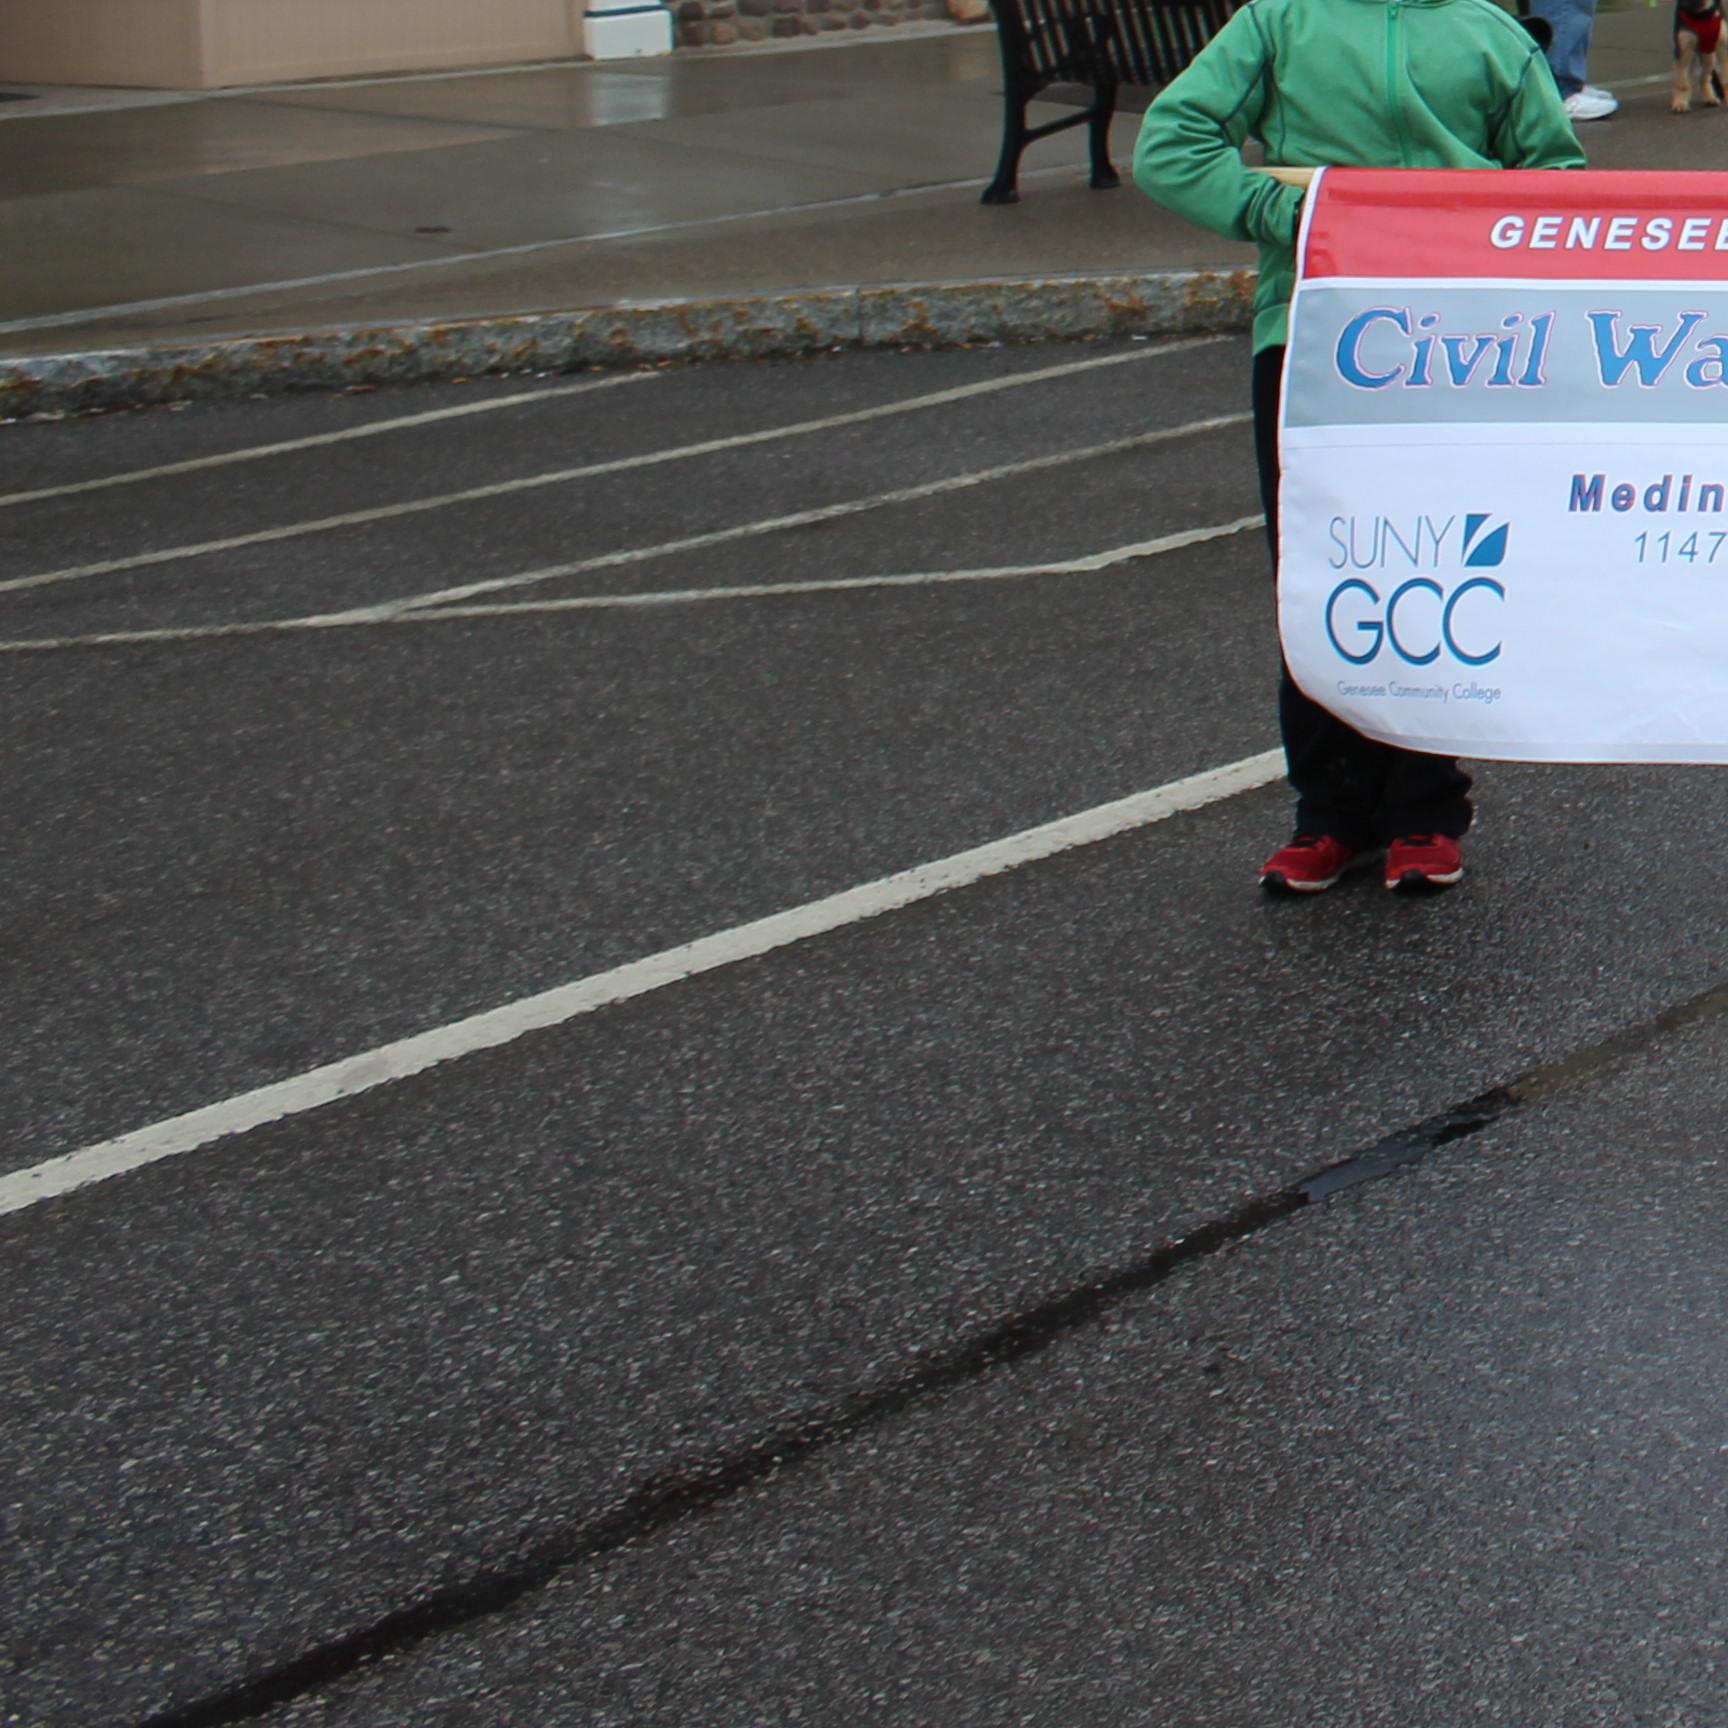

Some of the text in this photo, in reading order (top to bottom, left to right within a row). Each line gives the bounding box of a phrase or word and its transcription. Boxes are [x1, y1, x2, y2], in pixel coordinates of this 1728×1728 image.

[1334, 303, 1557, 392] Civil
[1328, 513, 1456, 569] SUNY
[1324, 576, 1507, 667] GCC
[1336, 680, 1502, 705] Genesee Community College
